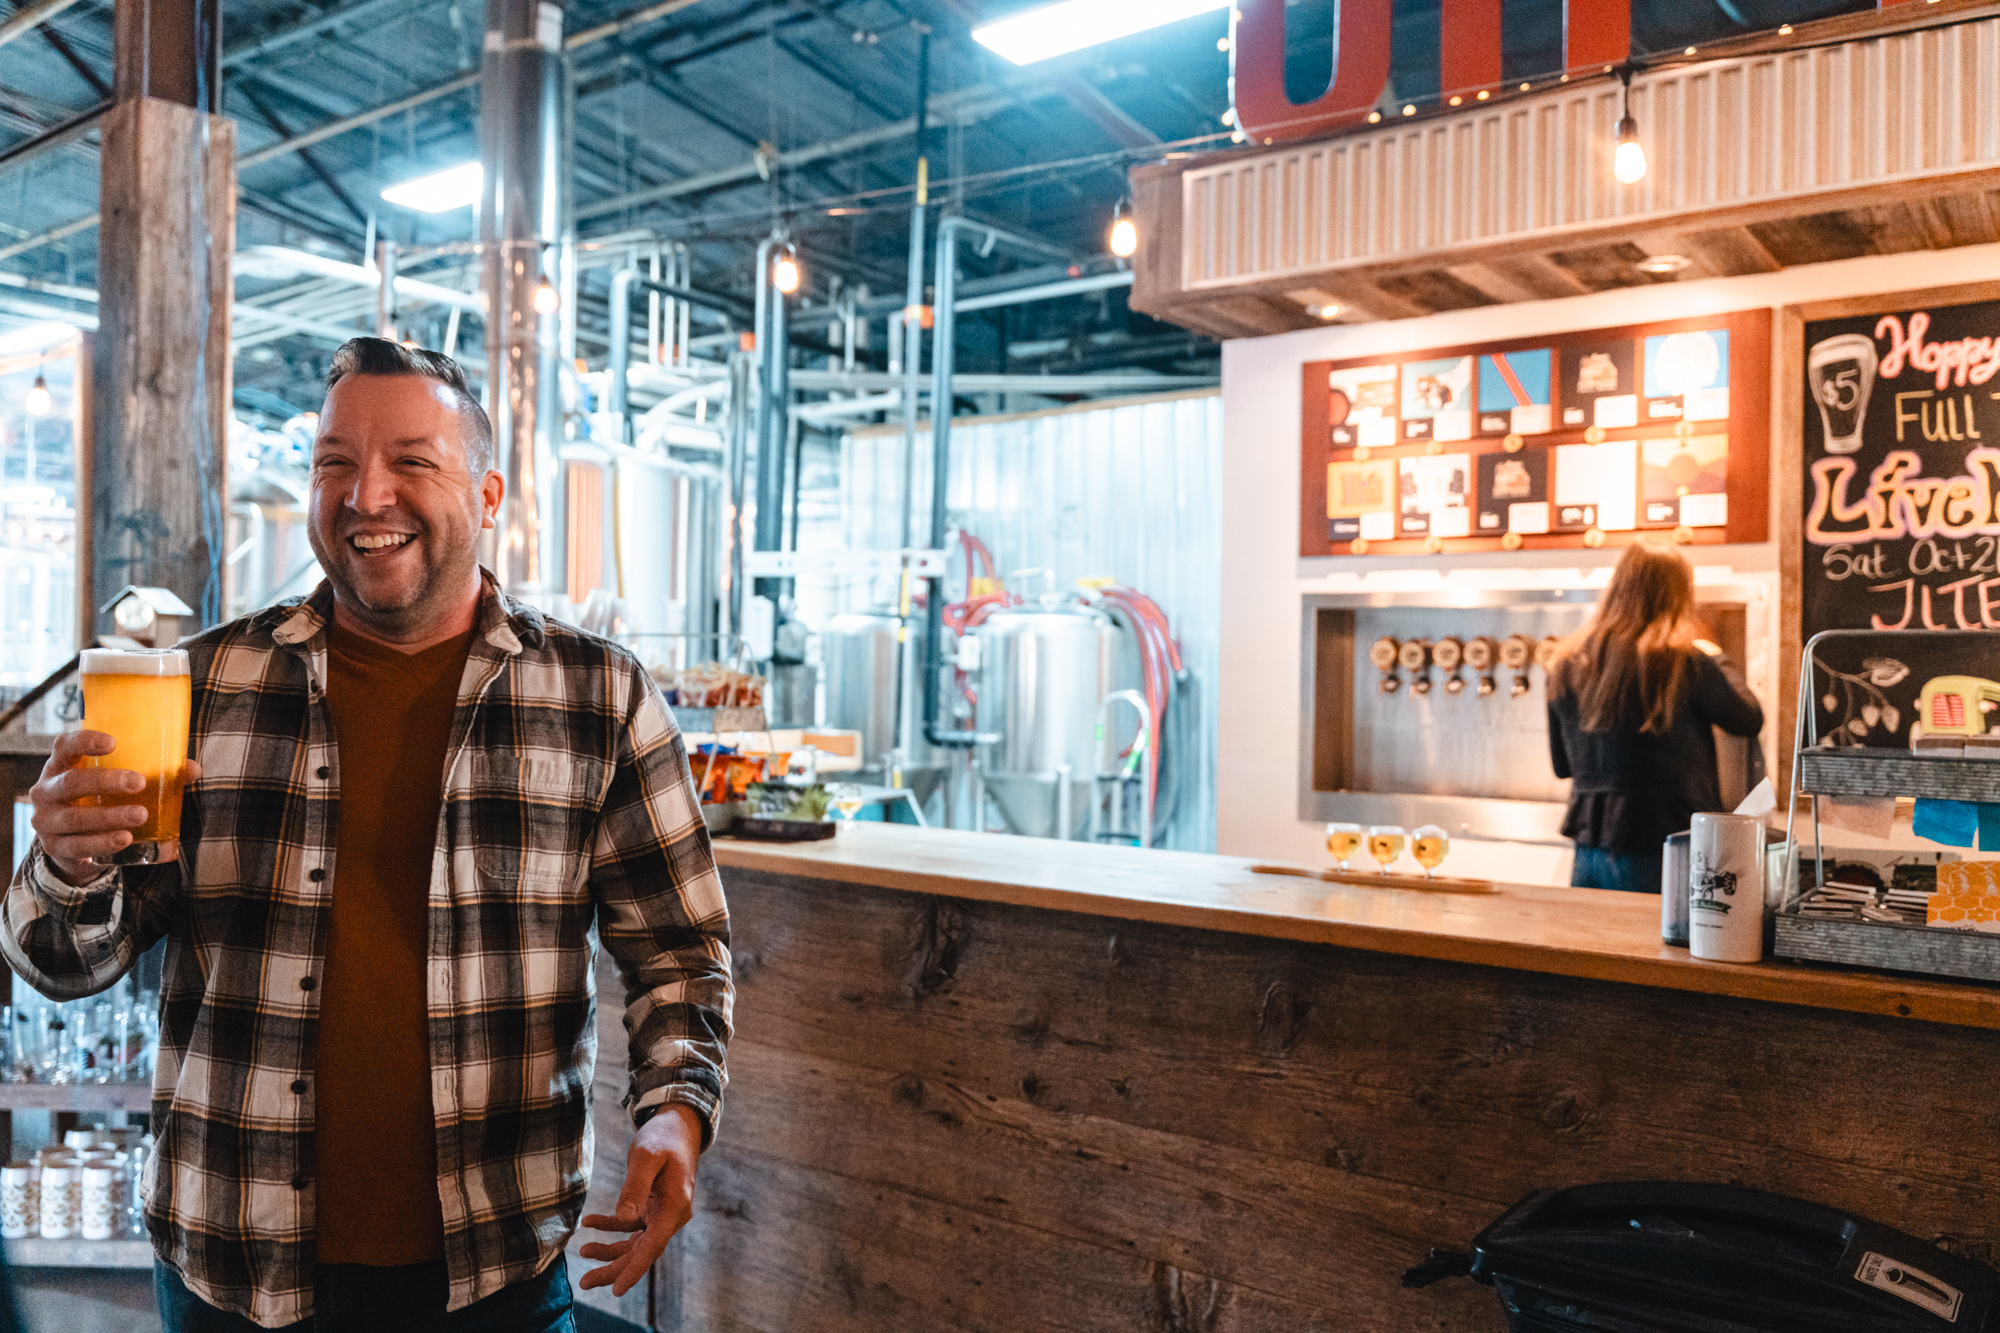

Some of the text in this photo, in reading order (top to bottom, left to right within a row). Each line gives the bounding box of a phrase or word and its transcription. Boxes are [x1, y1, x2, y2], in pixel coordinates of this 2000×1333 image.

[1821, 369, 1861, 411] $5
[1822, 543, 1901, 581] Sat
[1908, 538, 1972, 576] Oct
